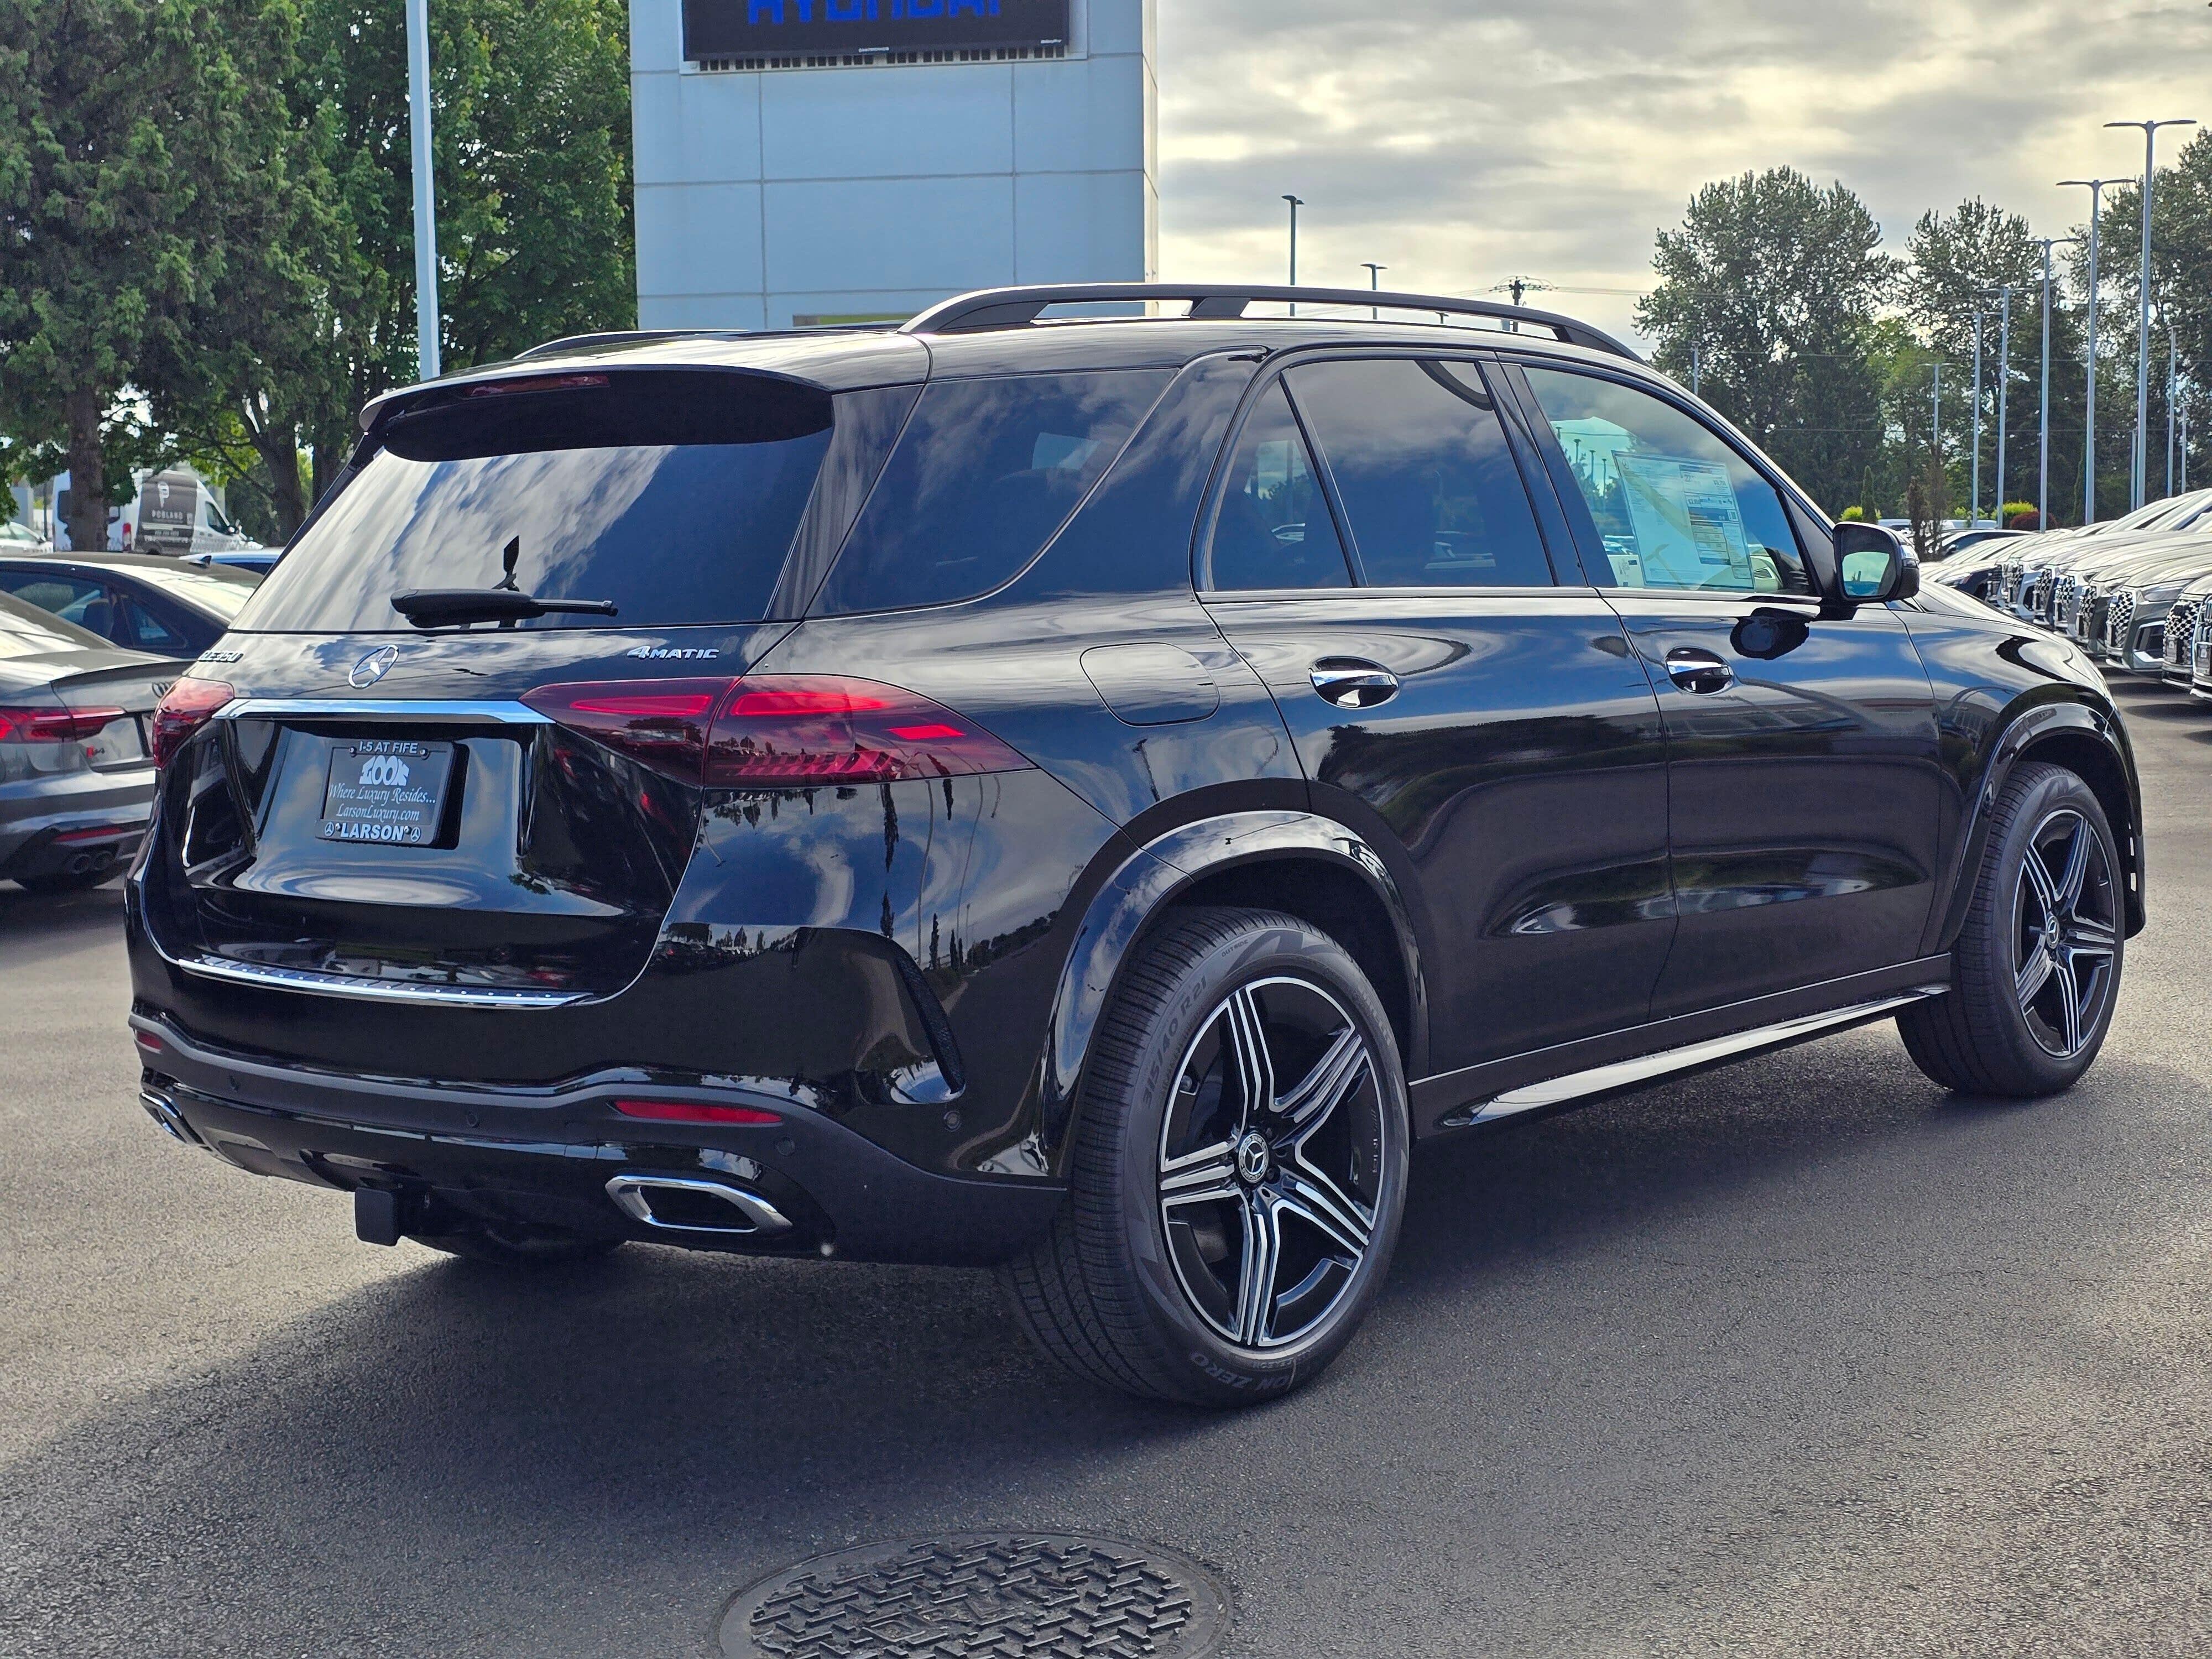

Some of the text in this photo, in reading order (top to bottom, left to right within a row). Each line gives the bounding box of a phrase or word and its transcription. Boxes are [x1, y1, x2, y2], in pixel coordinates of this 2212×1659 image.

[627, 645, 719, 659] 4MATIC
[359, 741, 418, 754] I-5 AT FIFE
[328, 782, 436, 806] Where Luxury Resides...
[336, 804, 420, 823] LarsonLuxury.com
[341, 822, 404, 841] LARSON
[1190, 1352, 1253, 1389] ZERO
